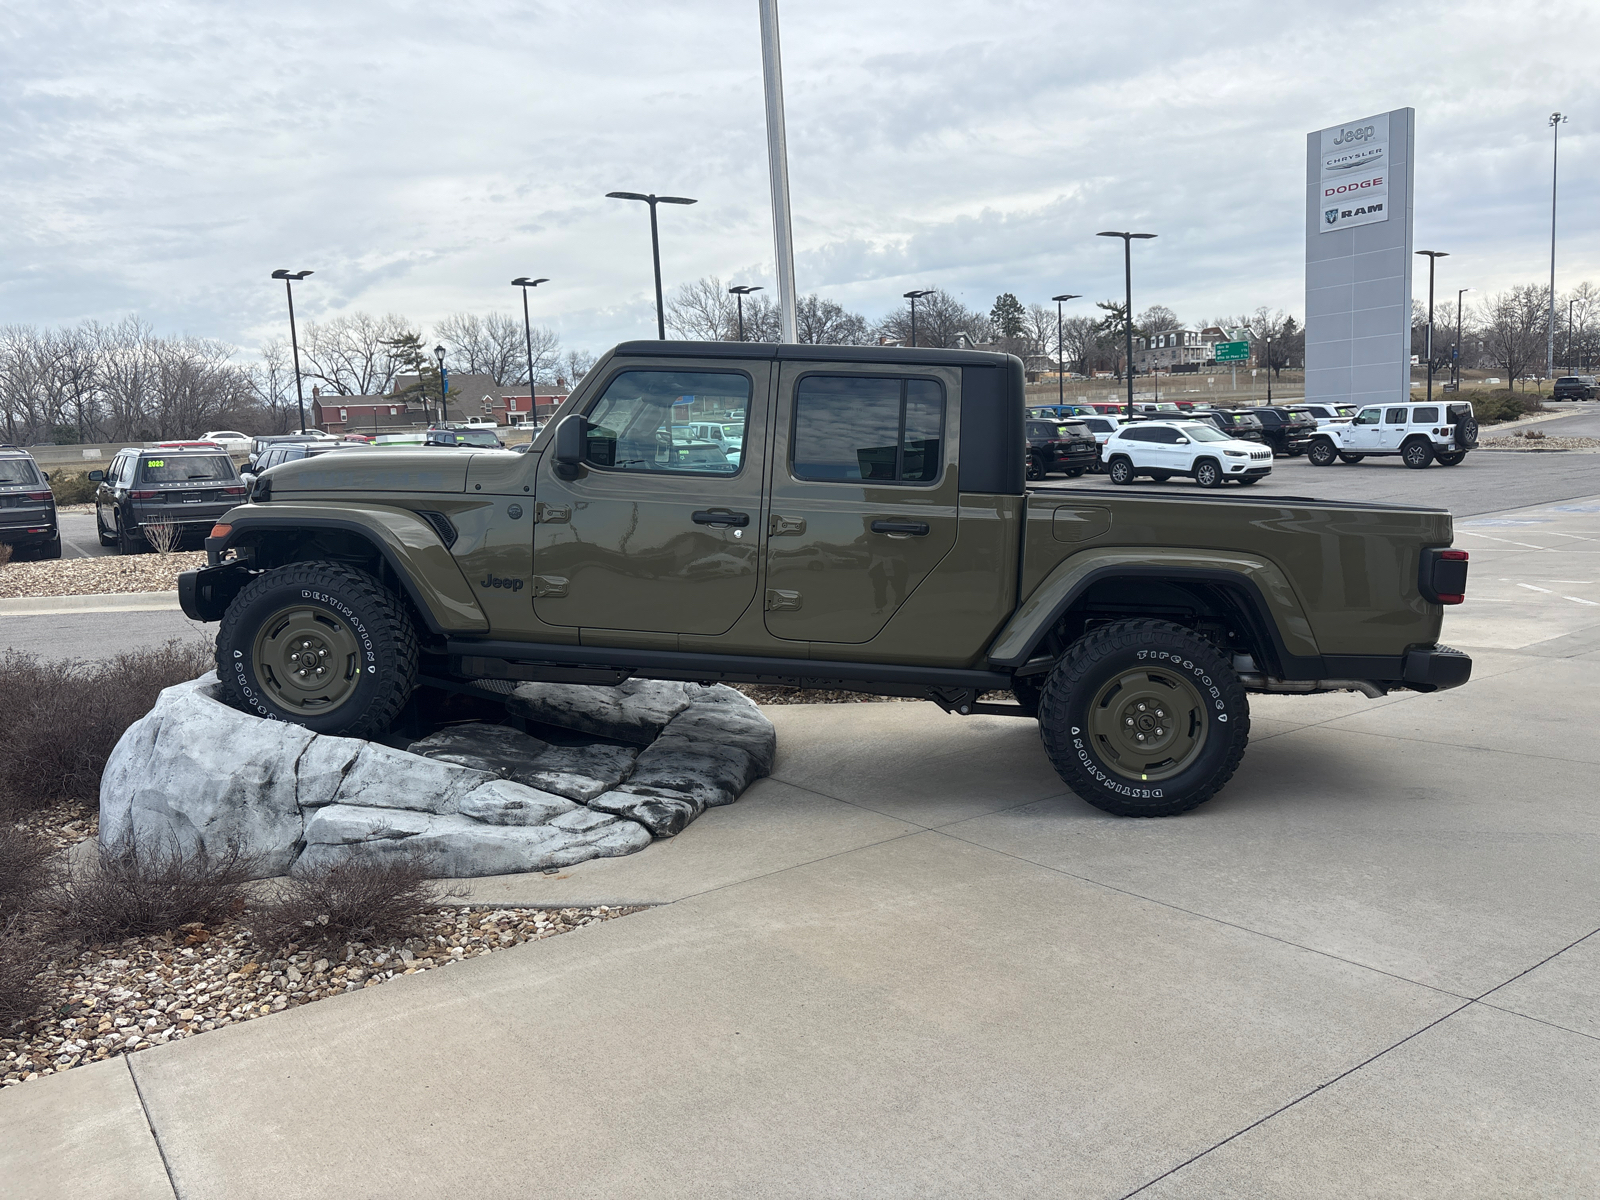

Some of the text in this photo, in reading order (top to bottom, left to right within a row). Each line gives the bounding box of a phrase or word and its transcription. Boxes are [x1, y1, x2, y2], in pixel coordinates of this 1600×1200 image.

[1333, 125, 1375, 145] Jeep
[1326, 148, 1383, 165] CHRYSLER
[1325, 177, 1383, 197] DODGE
[1341, 203, 1383, 219] RAM
[148, 460, 164, 468] 2023
[480, 573, 524, 592] Jeep
[301, 589, 376, 662] DESTINATION
[1136, 650, 1225, 710] Firestone
[1073, 737, 1164, 798] DESTINATION
